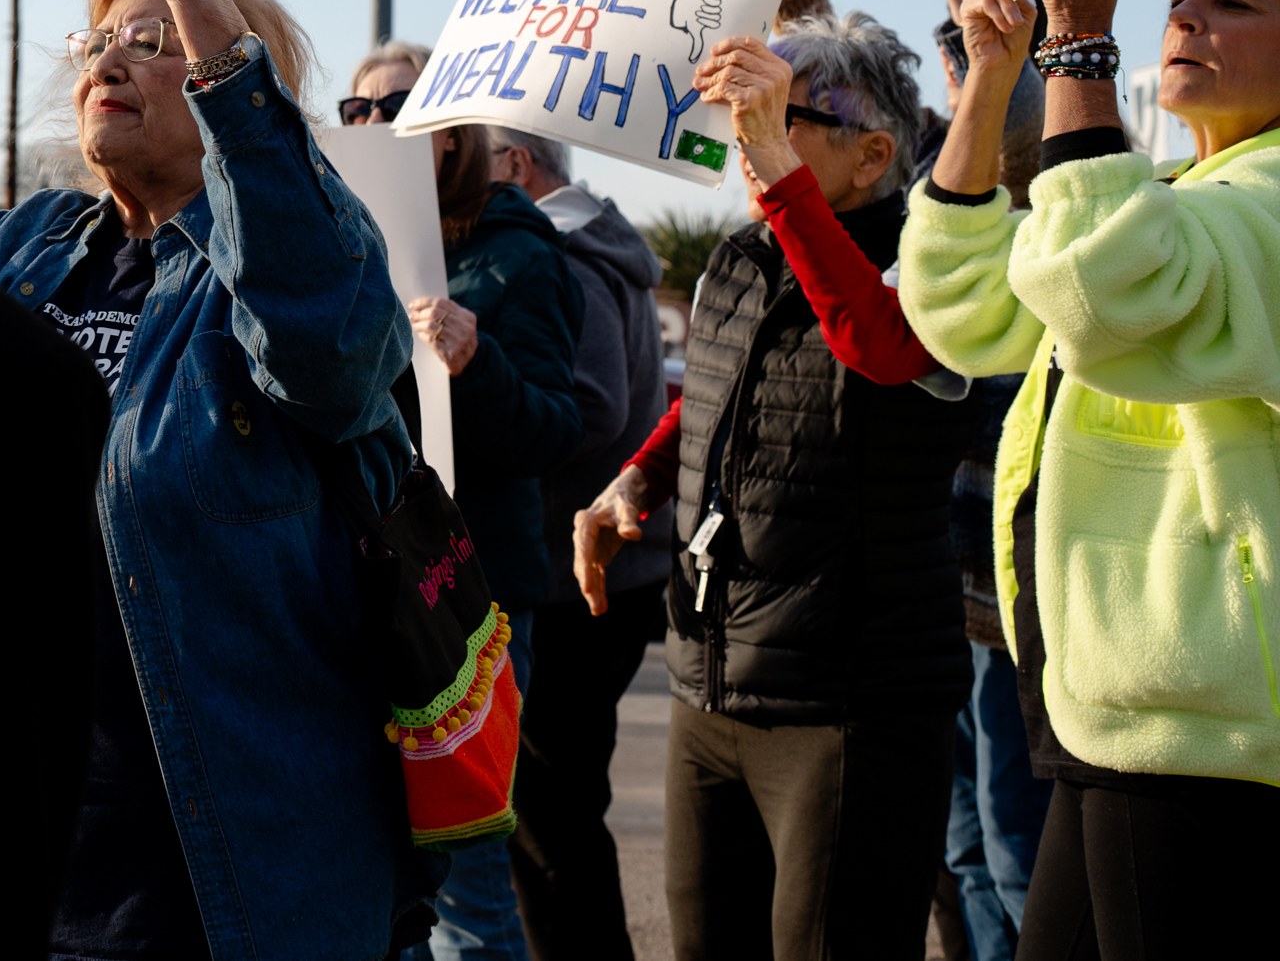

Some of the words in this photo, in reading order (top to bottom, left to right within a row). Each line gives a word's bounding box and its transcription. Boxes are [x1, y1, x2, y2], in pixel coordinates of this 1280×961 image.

[516, 5, 600, 50] FOR
[420, 40, 702, 161] WEALTHY
[43, 302, 86, 327] TEXAS
[94, 310, 141, 327] DEMO
